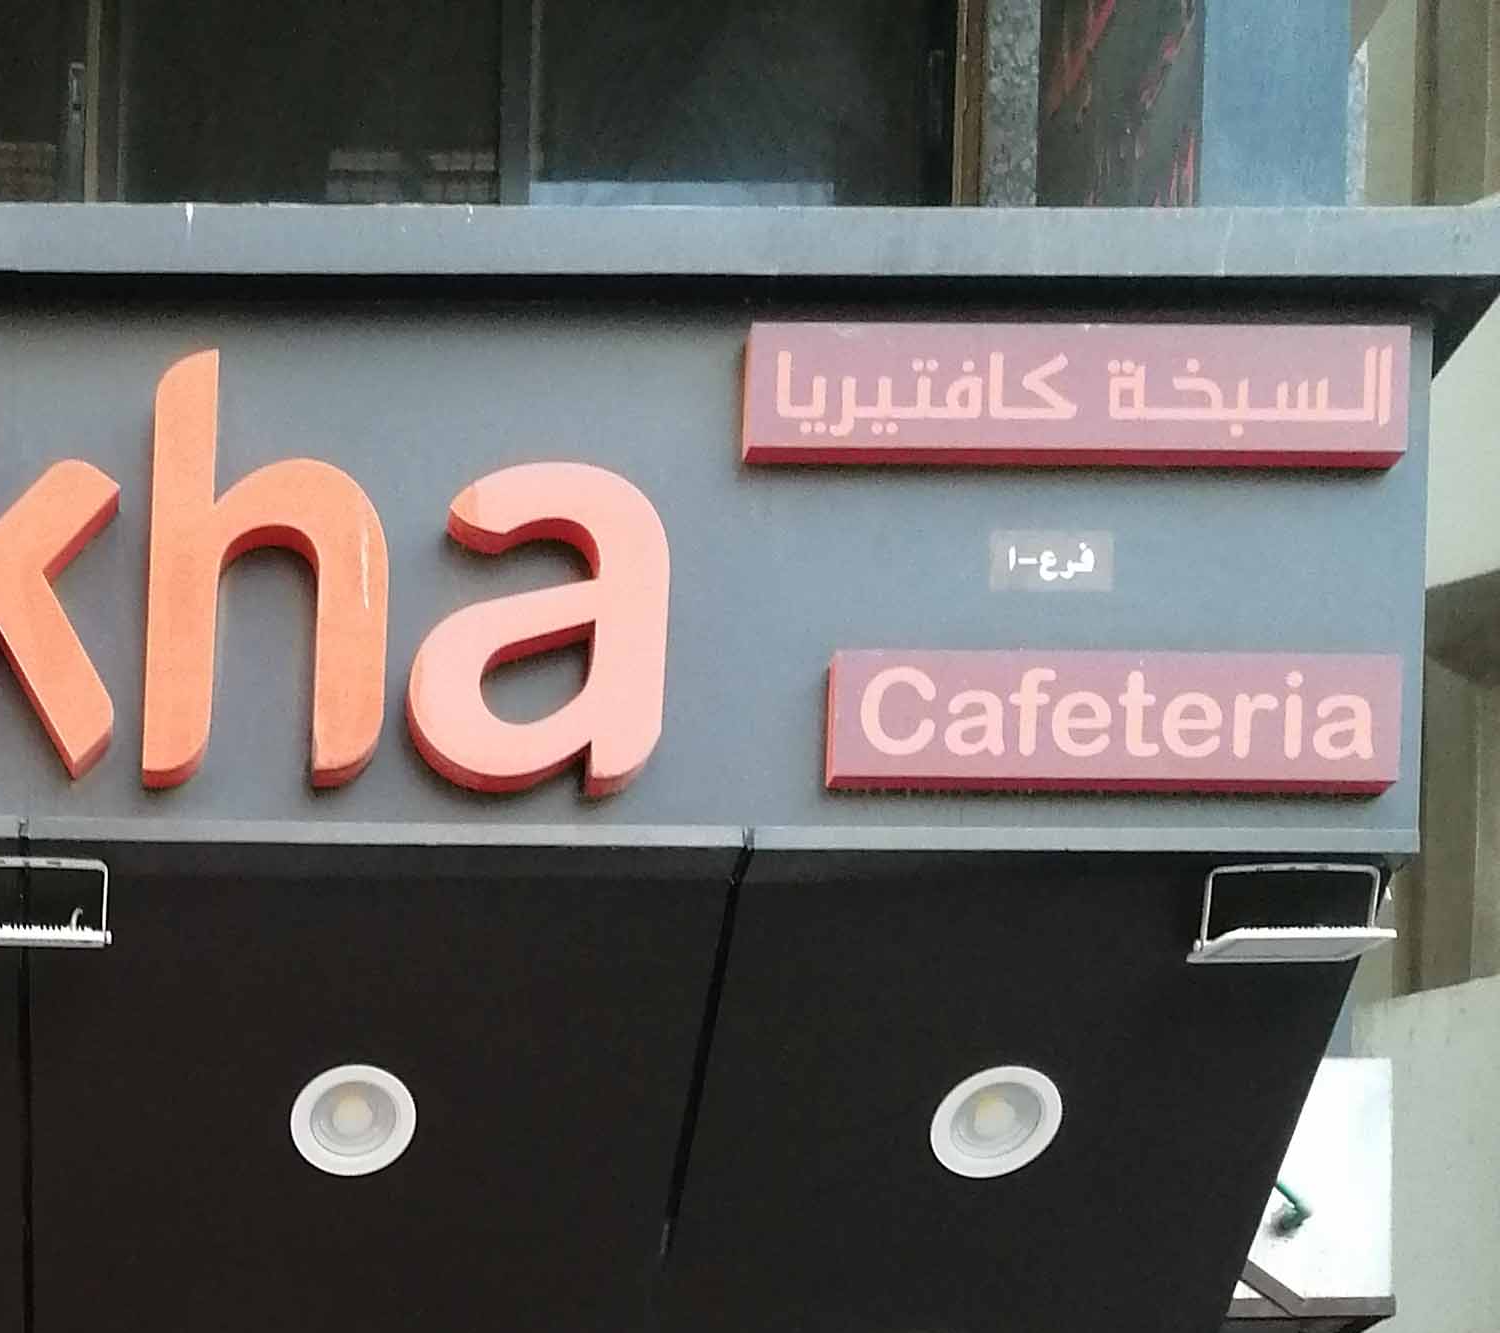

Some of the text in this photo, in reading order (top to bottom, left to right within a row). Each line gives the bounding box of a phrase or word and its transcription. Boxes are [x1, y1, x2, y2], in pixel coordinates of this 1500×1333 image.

[776, 346, 1394, 438] السبخة كافتيريا
[860, 666, 1374, 760] Cafeteria
